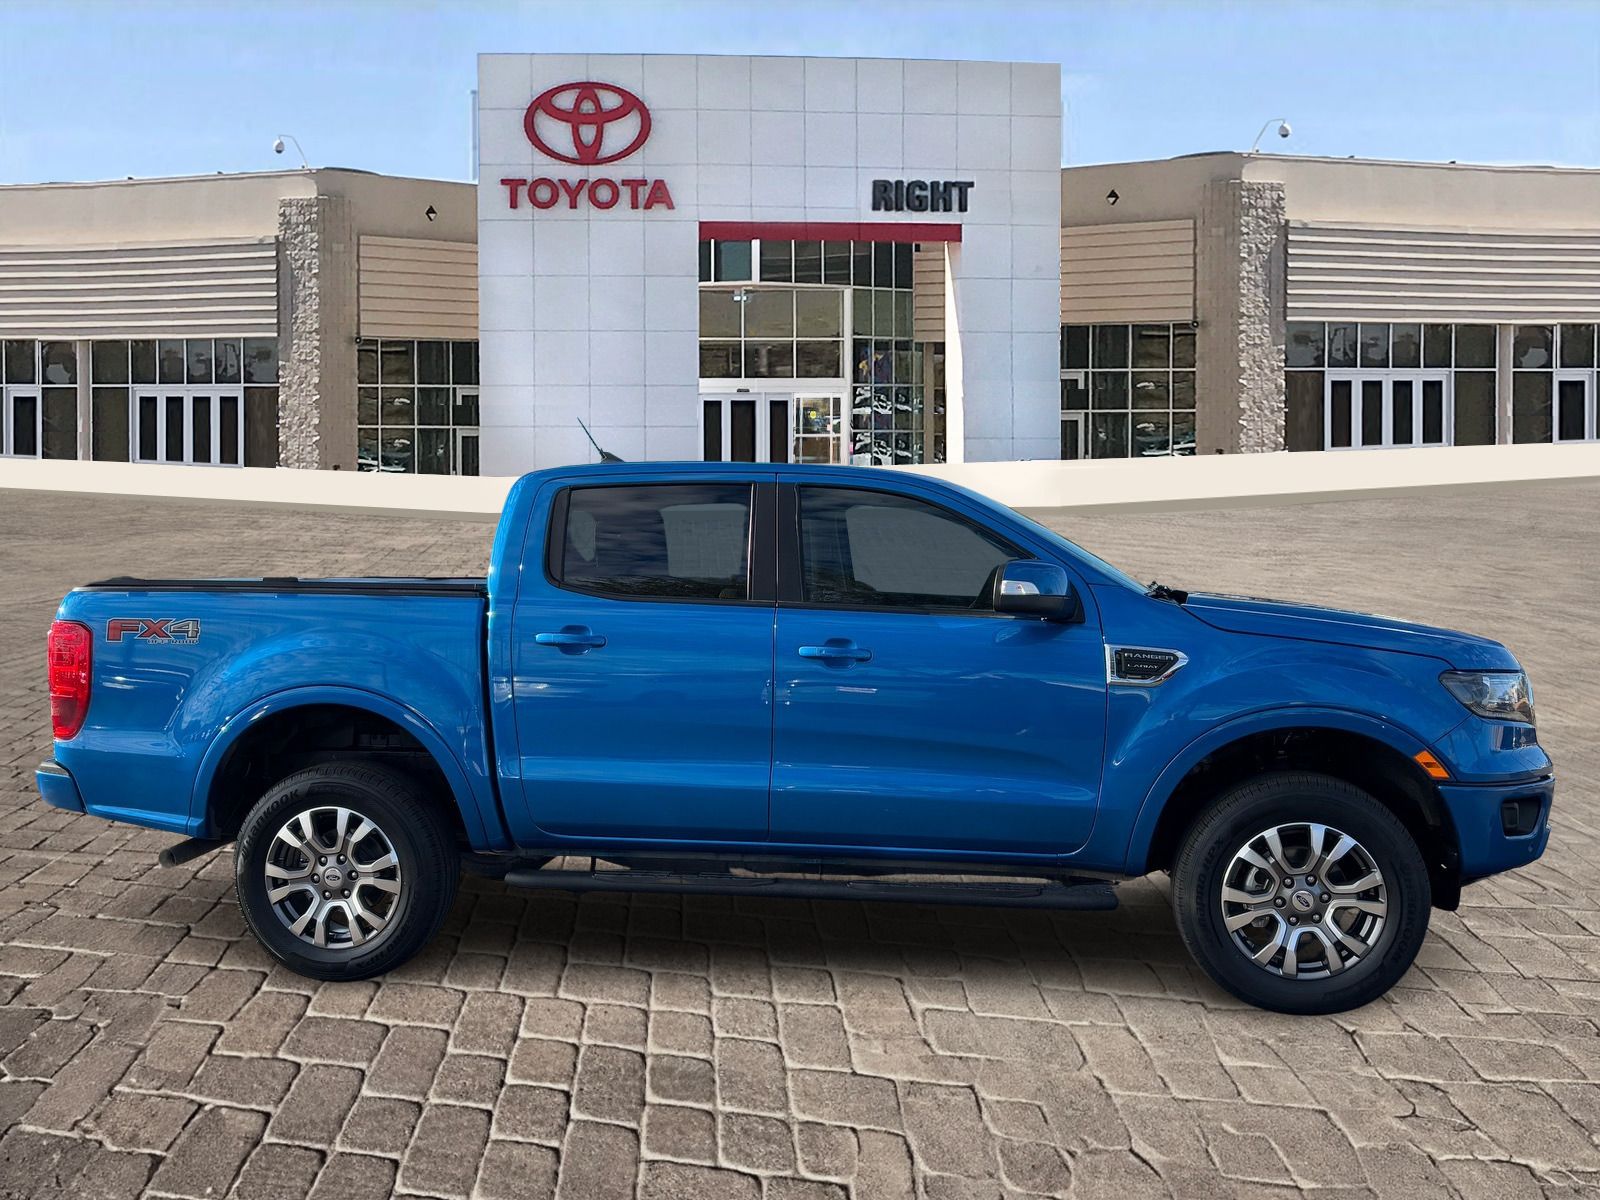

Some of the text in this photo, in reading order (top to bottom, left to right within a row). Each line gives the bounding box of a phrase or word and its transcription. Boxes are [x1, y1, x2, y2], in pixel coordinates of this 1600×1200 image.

[500, 177, 675, 210] TOYOTA
[871, 179, 975, 212] RIGHT
[106, 617, 201, 643] FX4
[1124, 652, 1175, 662] RANGER
